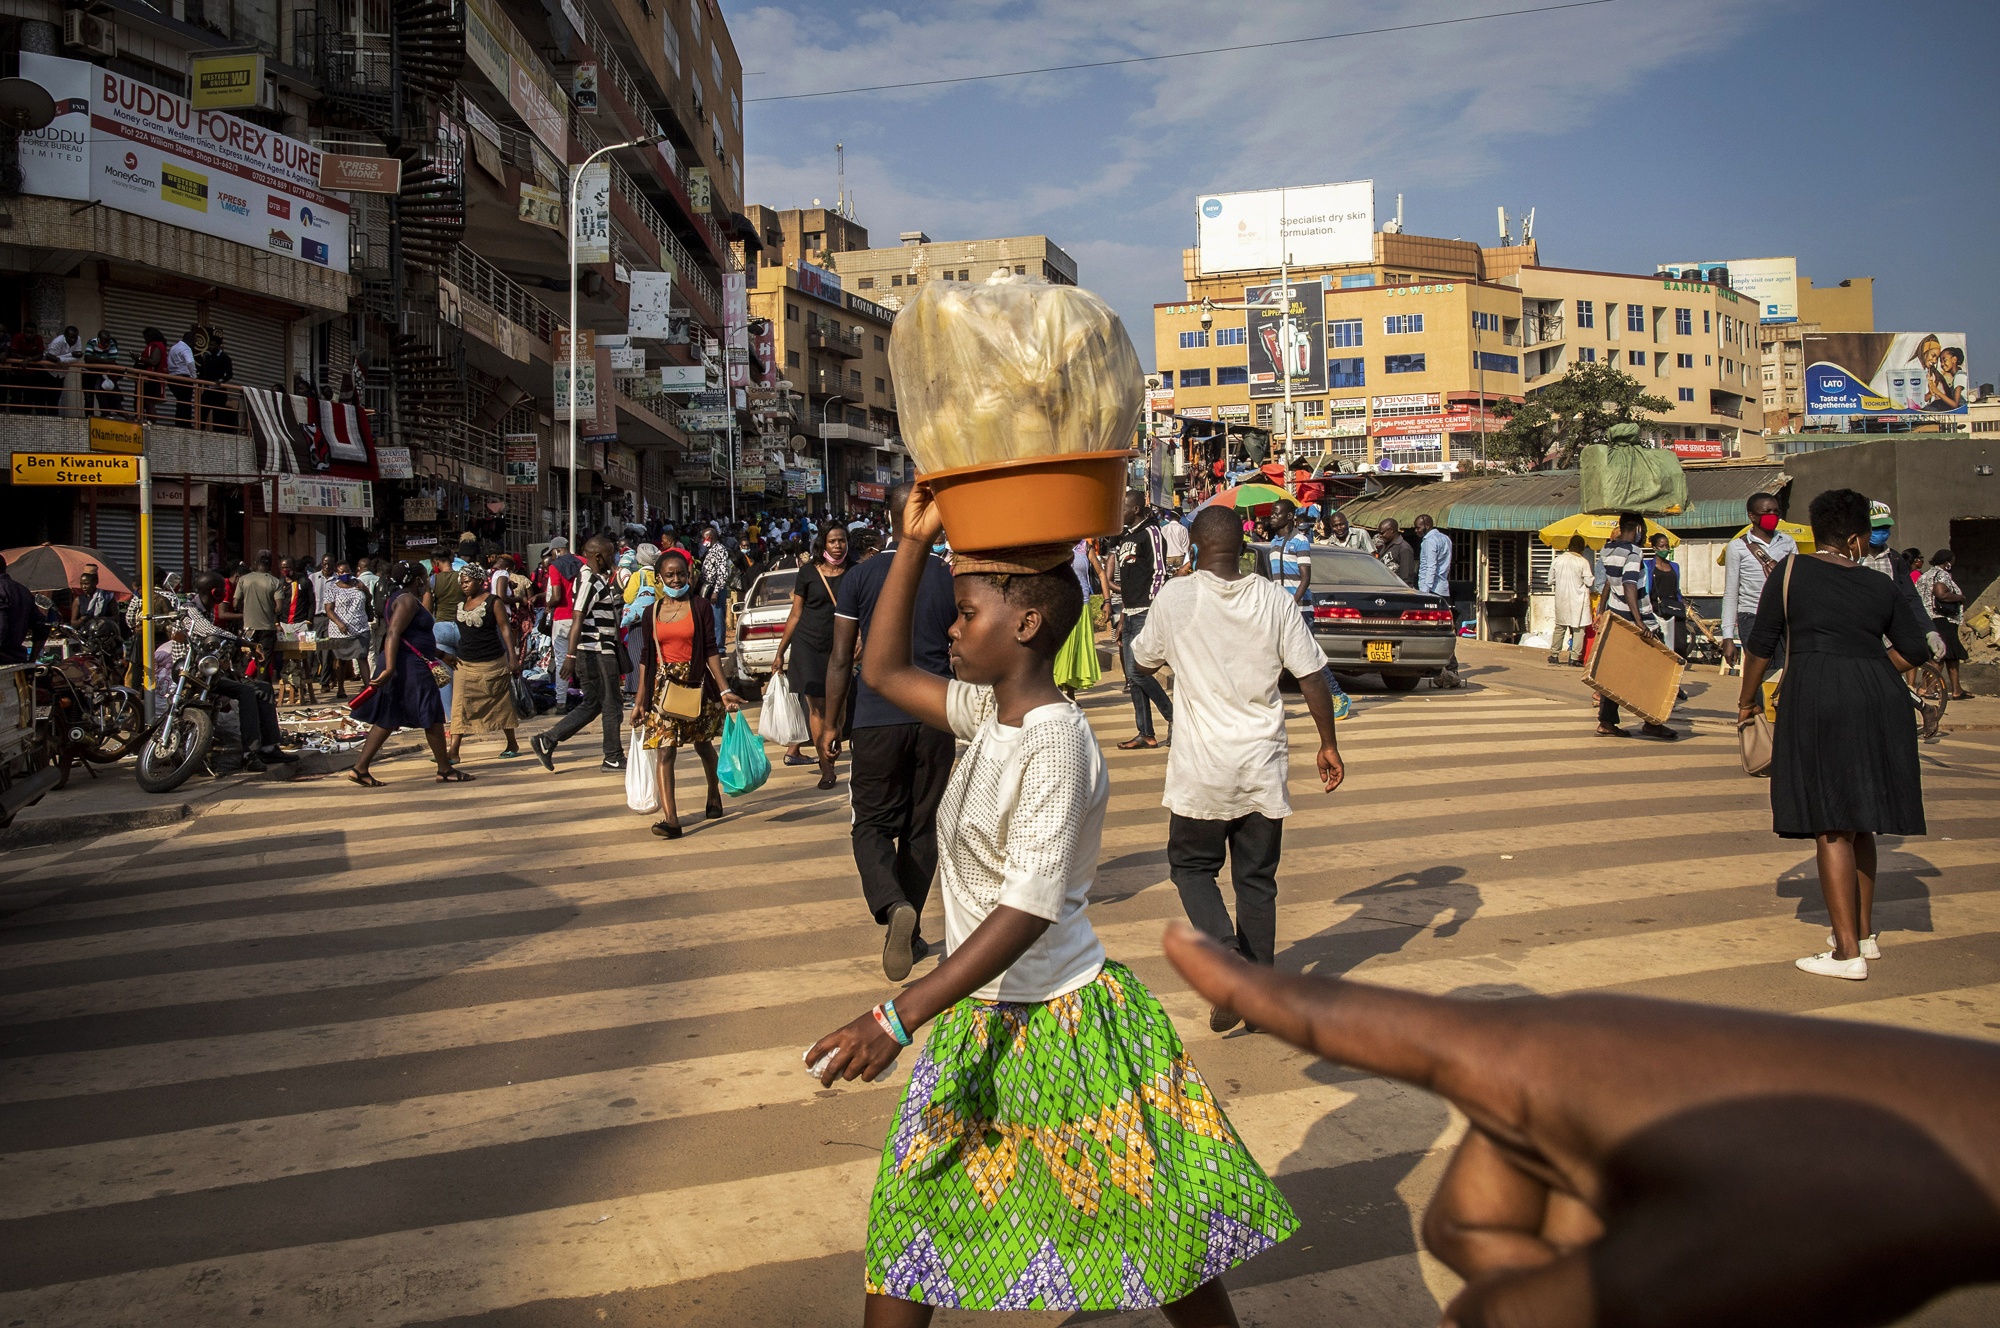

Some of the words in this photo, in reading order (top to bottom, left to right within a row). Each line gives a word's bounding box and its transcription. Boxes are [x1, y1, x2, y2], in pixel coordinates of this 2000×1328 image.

[103, 73, 190, 130] BUDDU
[198, 111, 267, 158] FOREX
[24, 138, 50, 148] FOREX
[52, 142, 82, 152] BUREAU
[114, 108, 140, 126] Money
[142, 118, 166, 134] Gram,
[168, 126, 195, 144] Western
[196, 138, 217, 152] Union,
[219, 145, 242, 160] Express
[244, 154, 266, 168] Money
[267, 163, 286, 176] Agent
[286, 169, 291, 178] &
[292, 172, 314, 188] Agency
[22, 148, 82, 162] LIMITED
[120, 125, 134, 138] Plot
[135, 129, 148, 141] 22A
[150, 134, 174, 150] William
[175, 144, 194, 158] Street,
[196, 150, 212, 163] Shop
[213, 156, 239, 172] L3-662/3
[252, 171, 266, 184] 0702
[266, 175, 276, 187] 274
[277, 178, 288, 190] 859
[292, 185, 306, 197] 0779
[316, 193, 325, 204] 702
[338, 160, 379, 170] XPRESS
[168, 174, 198, 188] WESTERN
[347, 170, 384, 180] MONEY
[112, 180, 128, 190] money
[129, 184, 148, 194] transfer
[176, 183, 198, 194] UNION
[218, 192, 246, 208] XPRESS
[268, 202, 280, 211] DTB
[224, 203, 250, 216] MONEY
[1280, 216, 1326, 227] Specialist
[1328, 214, 1344, 224] dry
[1346, 212, 1366, 220] skin
[1280, 227, 1336, 238] formulation.
[270, 236, 292, 249] EQUITY
[1386, 284, 1454, 297] TOWERS
[1664, 280, 1710, 294] HANIFA
[852, 296, 873, 315] ROYAL
[560, 333, 588, 344] KS
[95, 431, 132, 444] Namirembe
[134, 434, 144, 446] Rd.
[28, 456, 54, 467] Ben
[60, 456, 129, 468] Kiwanuka
[56, 471, 102, 482] Street
[876, 470, 890, 484] LIPU
[1375, 641, 1391, 651] UAT
